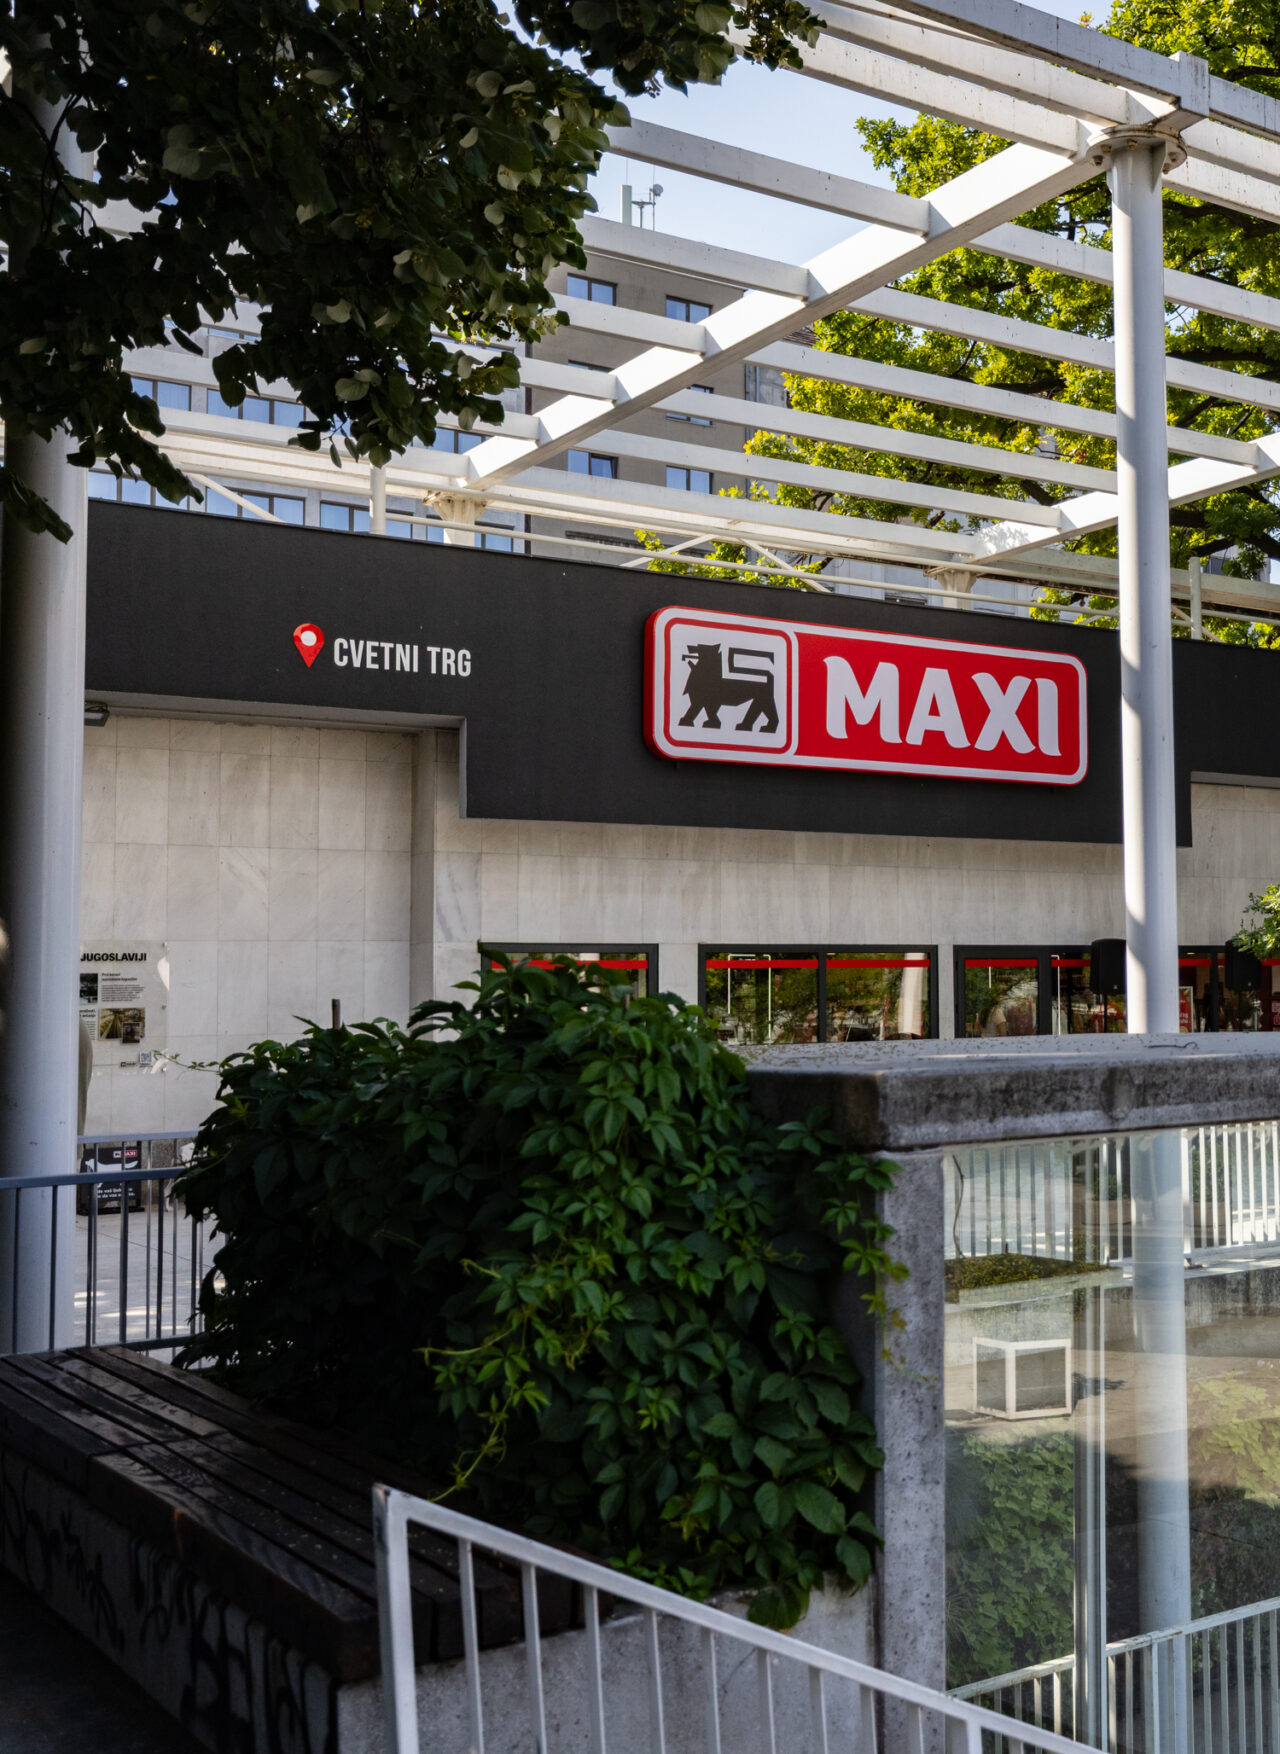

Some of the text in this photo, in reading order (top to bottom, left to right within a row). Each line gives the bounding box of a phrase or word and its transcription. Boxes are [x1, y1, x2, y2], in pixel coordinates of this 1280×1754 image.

[333, 637, 472, 678] CVETNI TRG
[822, 655, 1062, 757] MAXI
[80, 952, 147, 961] JUGOSLAVIJI
